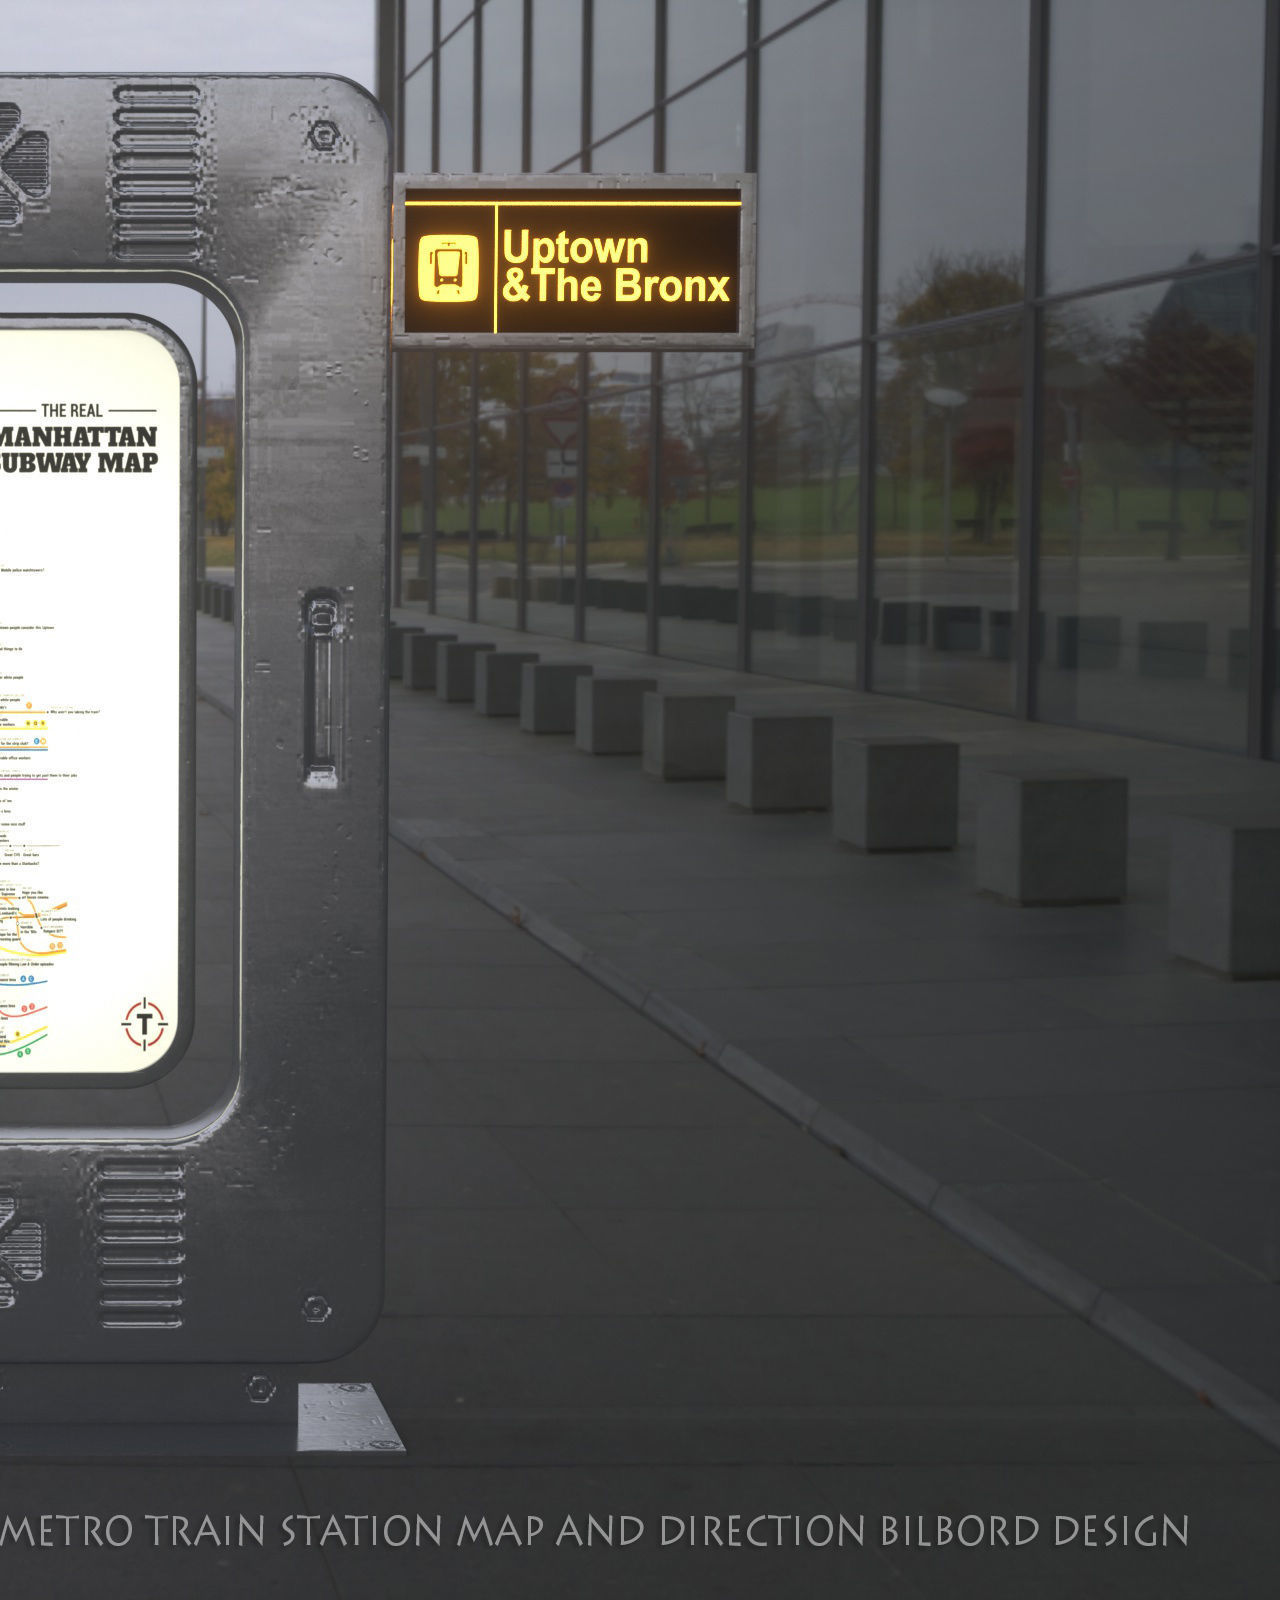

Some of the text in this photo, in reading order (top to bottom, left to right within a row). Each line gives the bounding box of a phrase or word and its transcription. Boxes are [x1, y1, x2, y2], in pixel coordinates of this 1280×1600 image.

[504, 229, 648, 267] Uptown
[502, 267, 730, 302] &The Bronx
[41, 403, 103, 417] THE REAL
[98, 452, 158, 473] MAP
[137, 1013, 153, 1035] T
